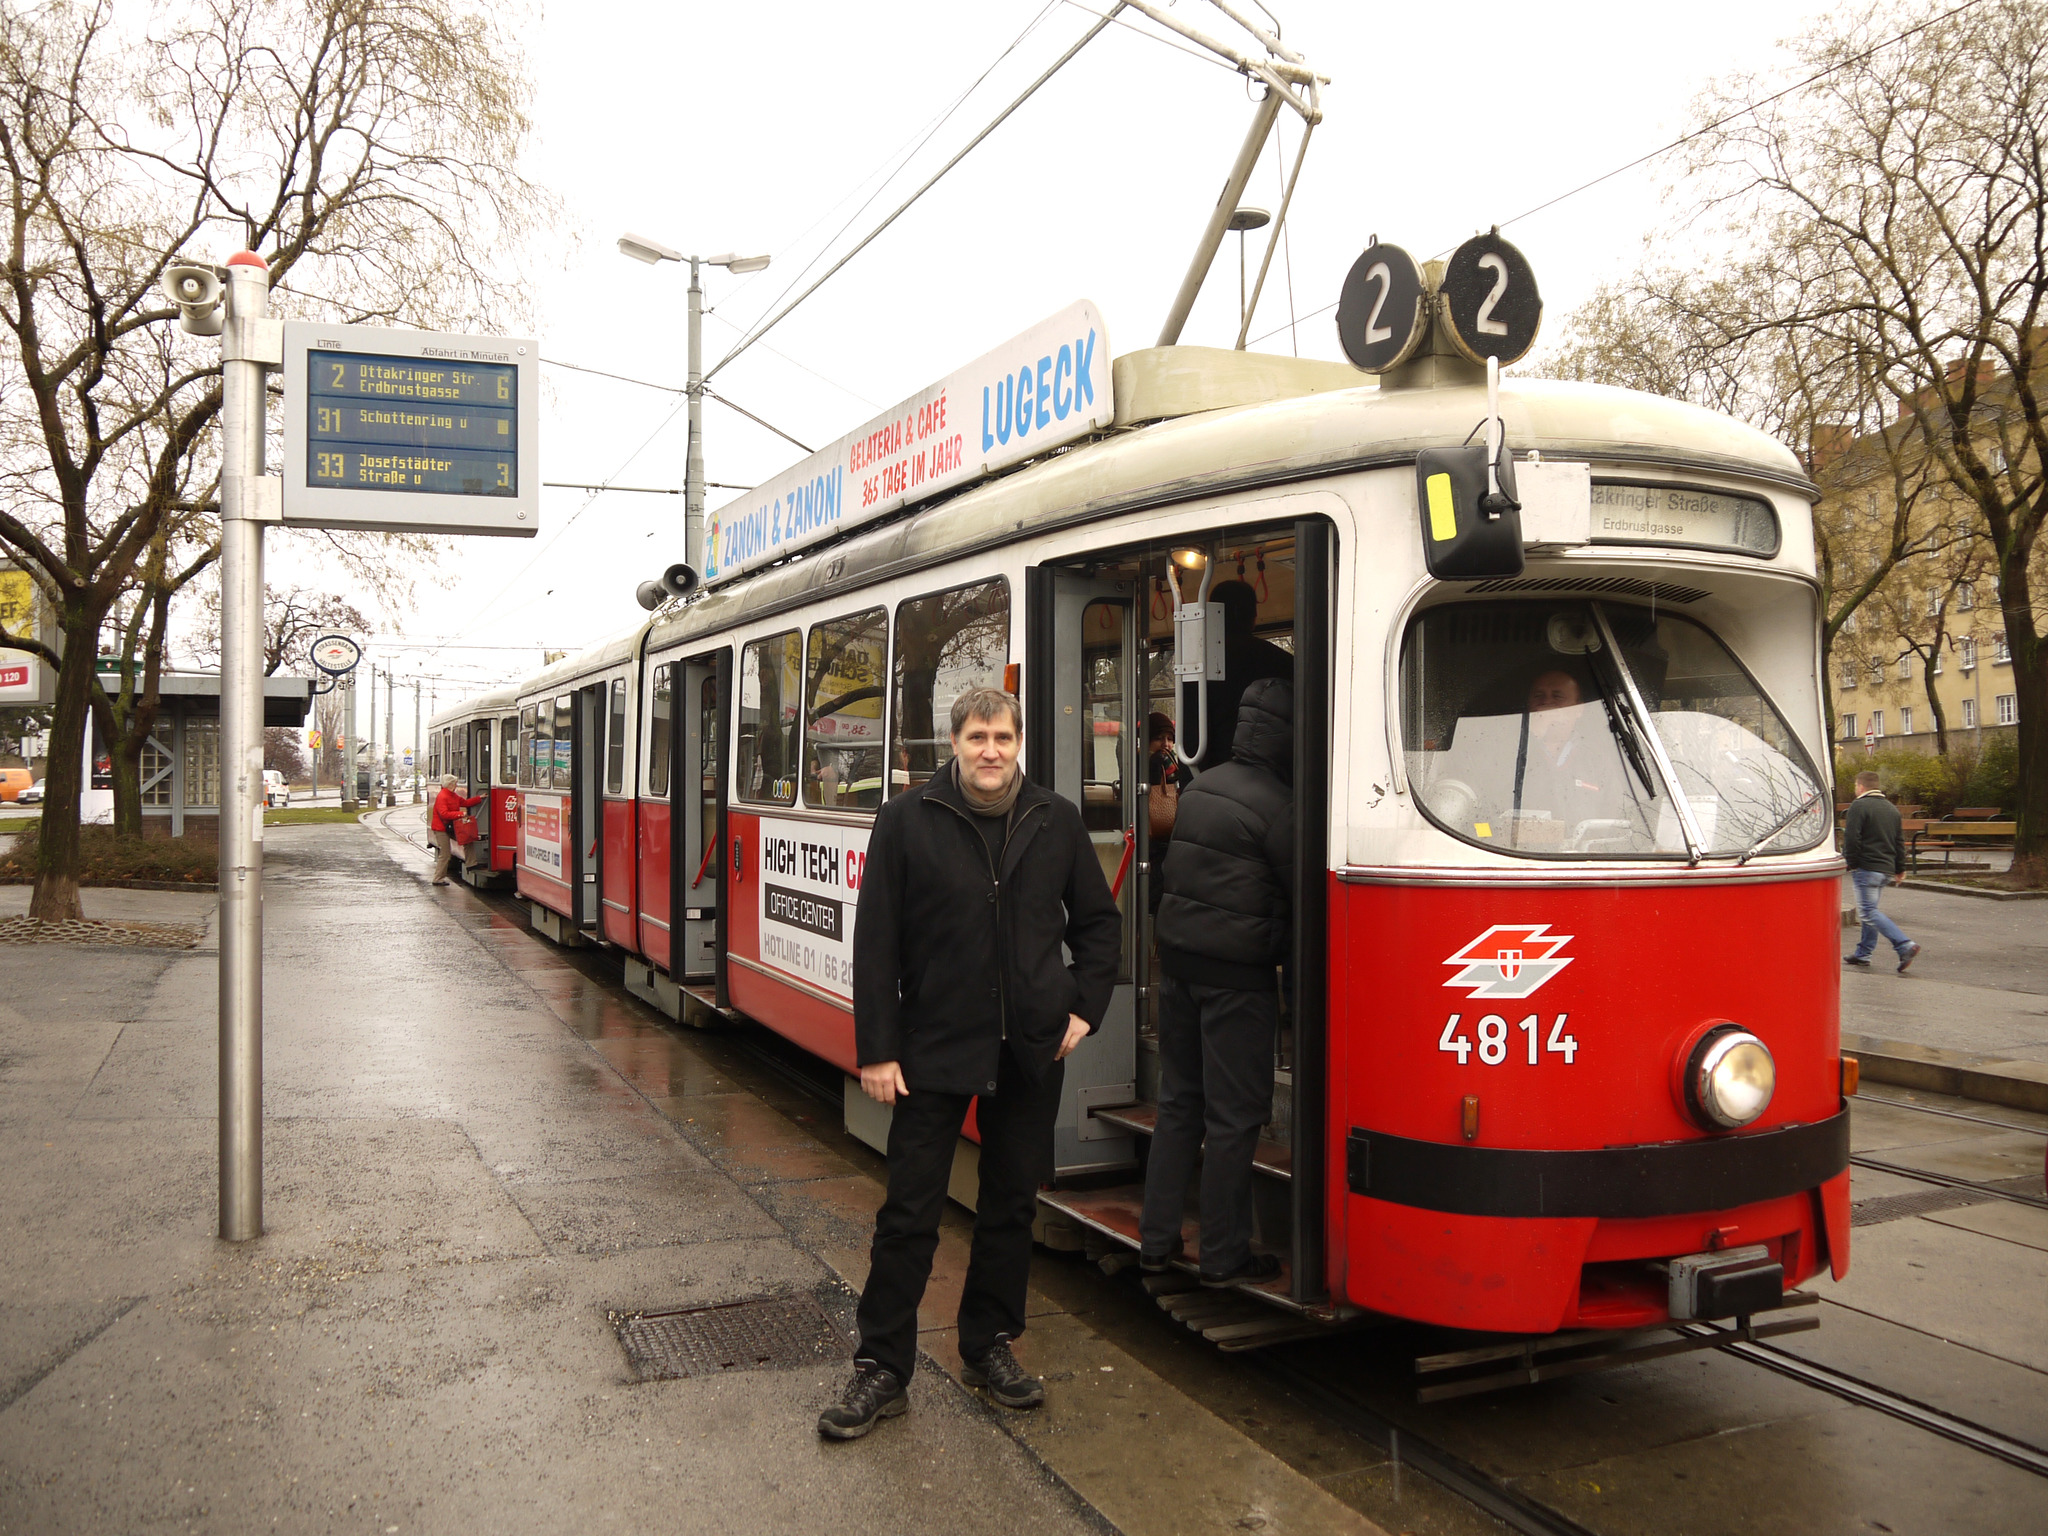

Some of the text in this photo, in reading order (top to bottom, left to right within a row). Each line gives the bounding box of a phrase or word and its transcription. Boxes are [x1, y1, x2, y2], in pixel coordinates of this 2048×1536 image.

[1365, 261, 1392, 345] 2
[1476, 251, 1509, 336] 2
[317, 339, 342, 349] Linie
[421, 346, 510, 362] Abfahrt in Minuten
[332, 363, 345, 388] 2
[360, 364, 481, 386] Ottakringer Str.
[360, 379, 460, 399] Erdbrustgasse
[497, 376, 509, 400] 6
[981, 327, 1096, 454] LUGECK
[317, 407, 341, 433] 31
[360, 409, 453, 429] Schottenring
[849, 387, 947, 474] GELATERIA & CAFÉ
[317, 453, 345, 478] 33
[360, 454, 452, 472] Josefstädter
[497, 463, 509, 487] 3
[862, 433, 963, 508] 365 TAGE IM JAHR
[360, 469, 406, 485] Straße
[724, 464, 843, 567] ZANONI & ZANONI
[1667, 493, 1720, 513] Straße
[1603, 517, 1684, 535] Erdbrustgasse
[4, 672, 20, 683] 120
[764, 837, 796, 876] HIGH
[801, 842, 839, 885] TECH
[770, 891, 835, 932] OFFICE CENTER
[764, 932, 801, 966] HOTLINE
[803, 946, 816, 973] 01
[824, 954, 838, 981] 66
[1438, 1013, 1578, 1066] 4814
